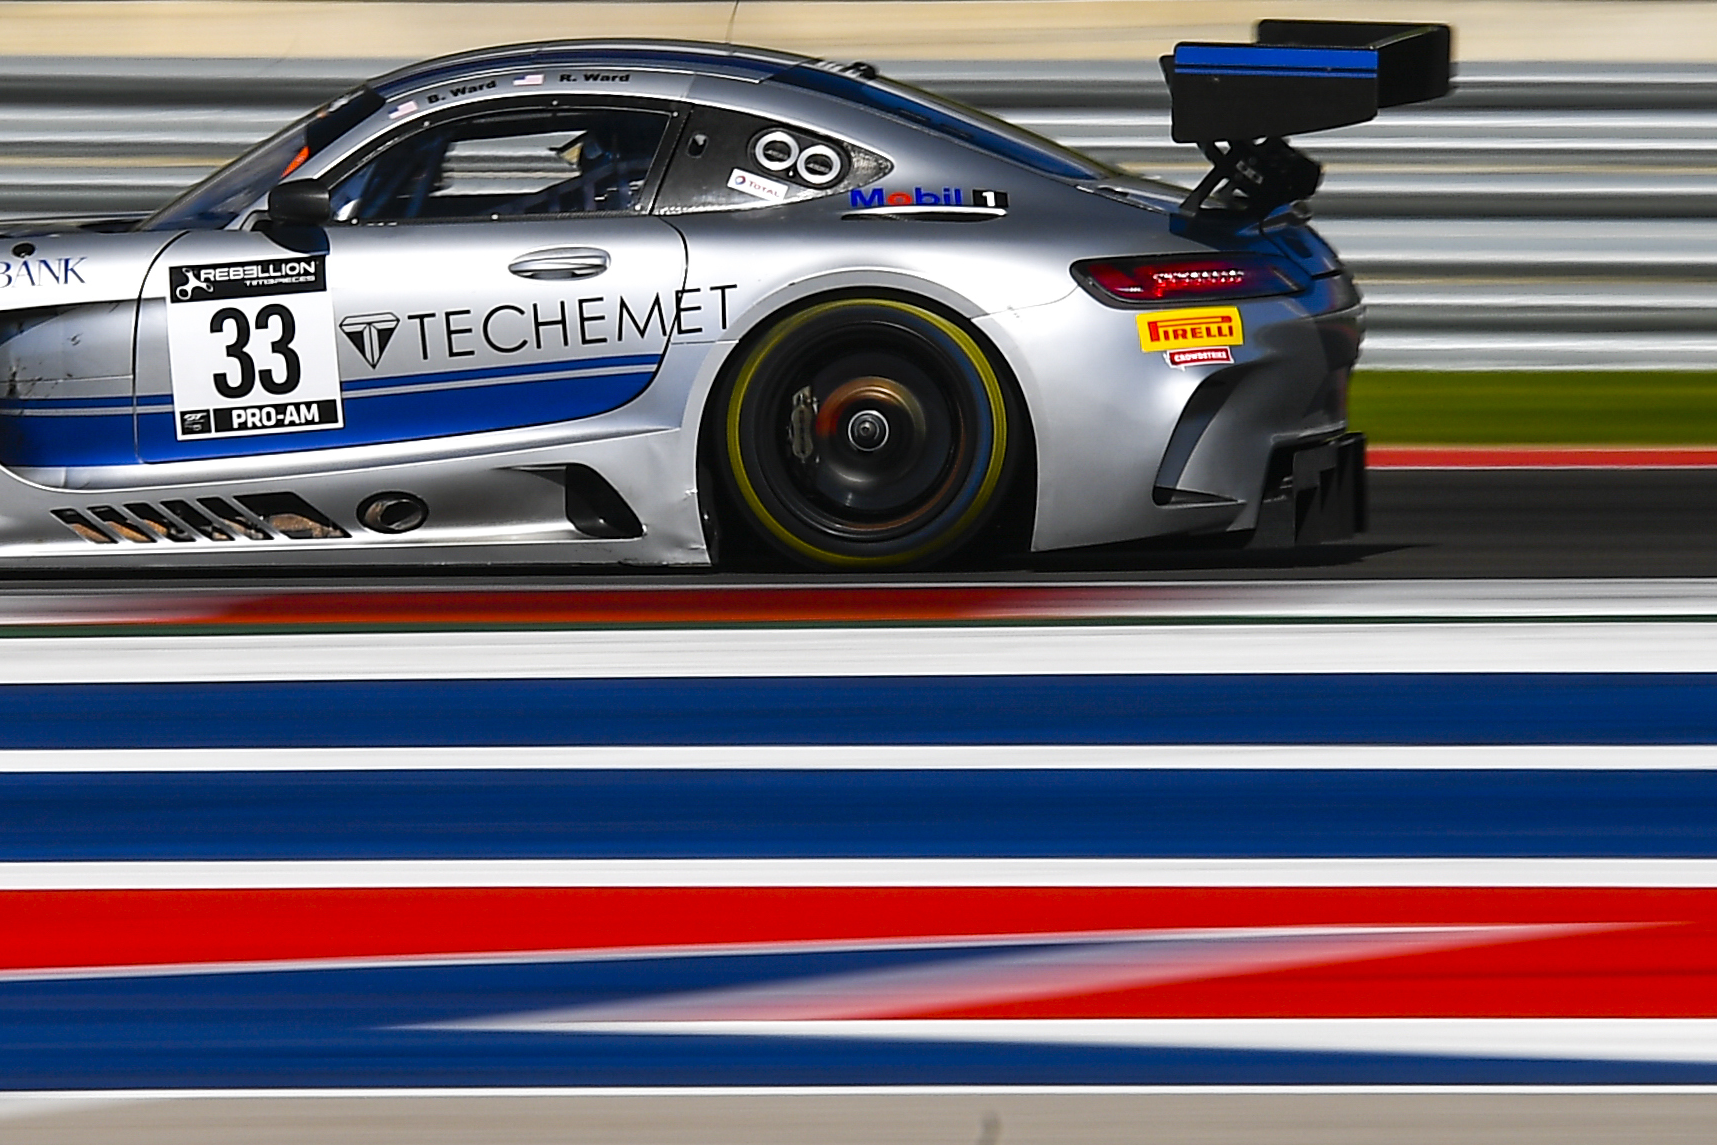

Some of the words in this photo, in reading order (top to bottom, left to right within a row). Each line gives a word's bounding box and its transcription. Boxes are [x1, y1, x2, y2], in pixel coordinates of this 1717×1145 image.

[559, 74, 577, 82] R.
[584, 73, 630, 82] Ward
[427, 94, 445, 104] B.
[450, 80, 497, 98] Ward
[749, 180, 780, 198] TOTAL
[850, 187, 963, 207] Mobil
[407, 284, 738, 361] TECHEMET
[1147, 316, 1234, 343] PIRELLI
[210, 304, 301, 399] 33
[1174, 351, 1227, 362] CROWDSTRIKE
[232, 403, 320, 429] PRO-AM
